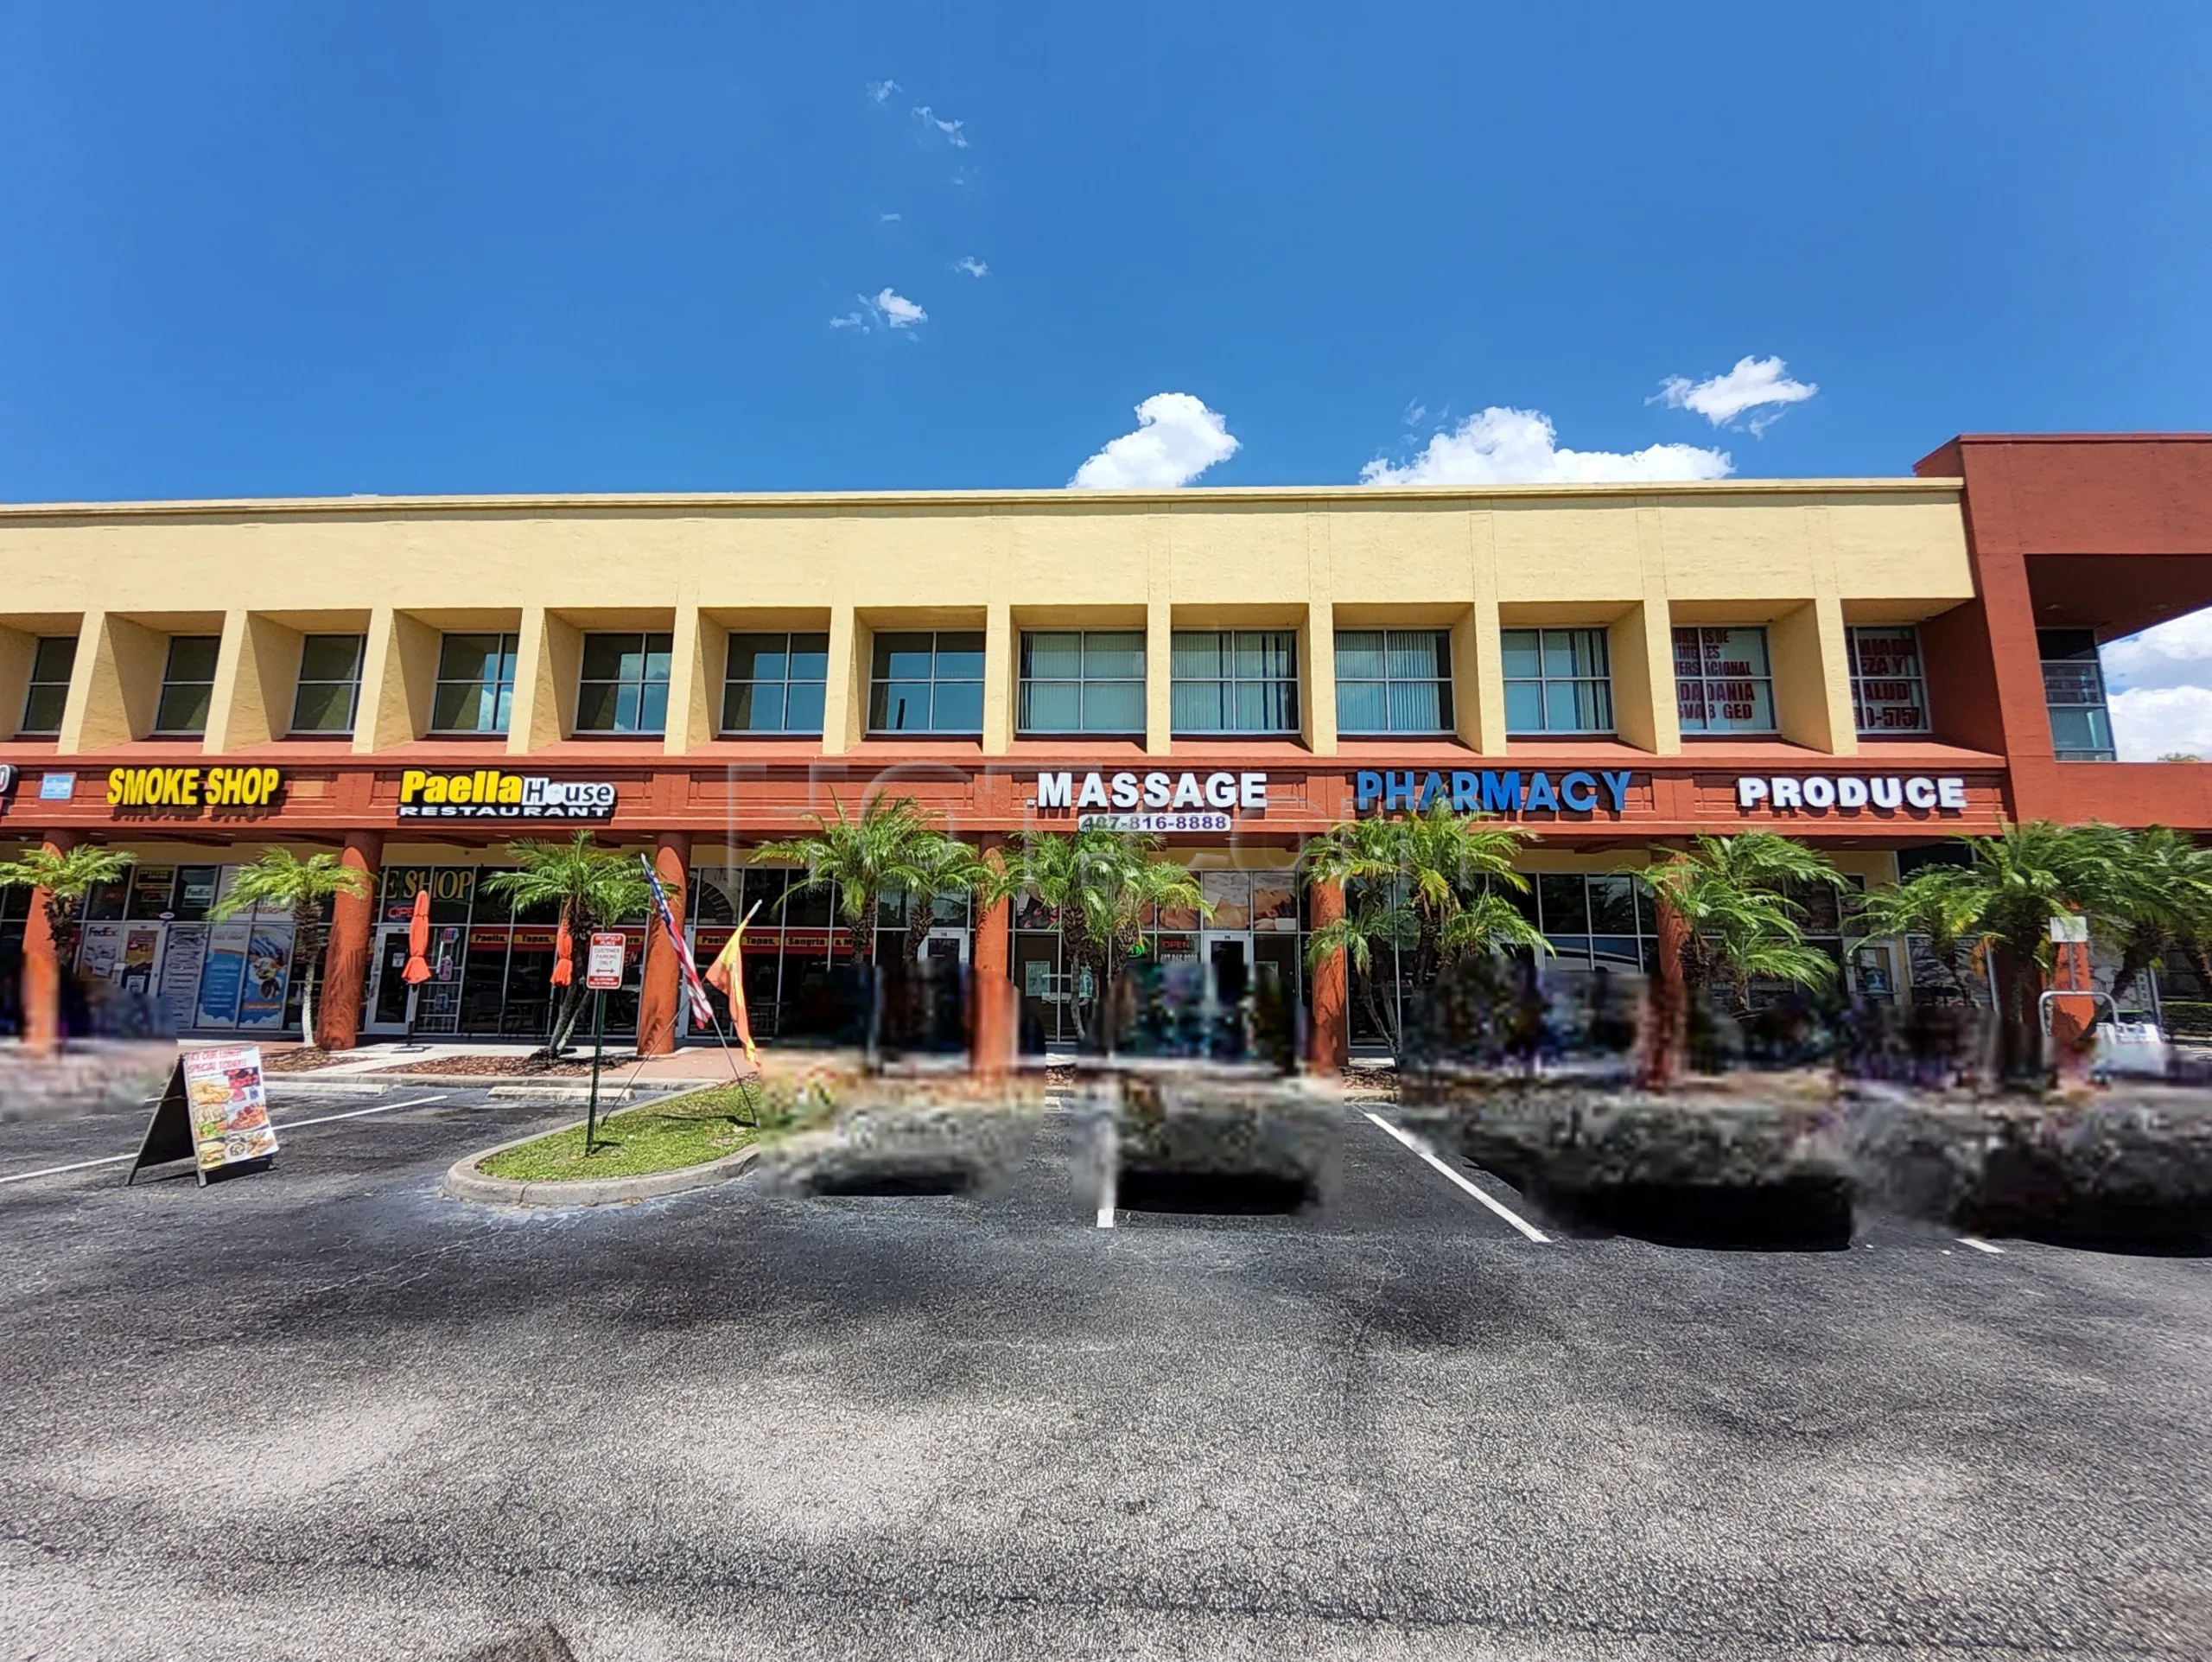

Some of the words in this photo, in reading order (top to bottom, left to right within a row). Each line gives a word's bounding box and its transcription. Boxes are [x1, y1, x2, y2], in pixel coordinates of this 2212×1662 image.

[1680, 683, 1755, 701] DADANIA
[1723, 704, 1752, 719] GED
[105, 767, 200, 806] SMOKE
[205, 767, 279, 806] SHOP
[400, 770, 523, 805] Paella
[1038, 773, 1268, 808] MASSAGE
[1357, 770, 1632, 812] PHARMACY
[1738, 777, 1967, 808] PRODUCE
[399, 806, 609, 817] RESTAURANT
[404, 869, 474, 900] SHOP
[387, 907, 416, 919] OPE
[788, 937, 826, 946] Sangria
[1161, 940, 1190, 949] OPEN
